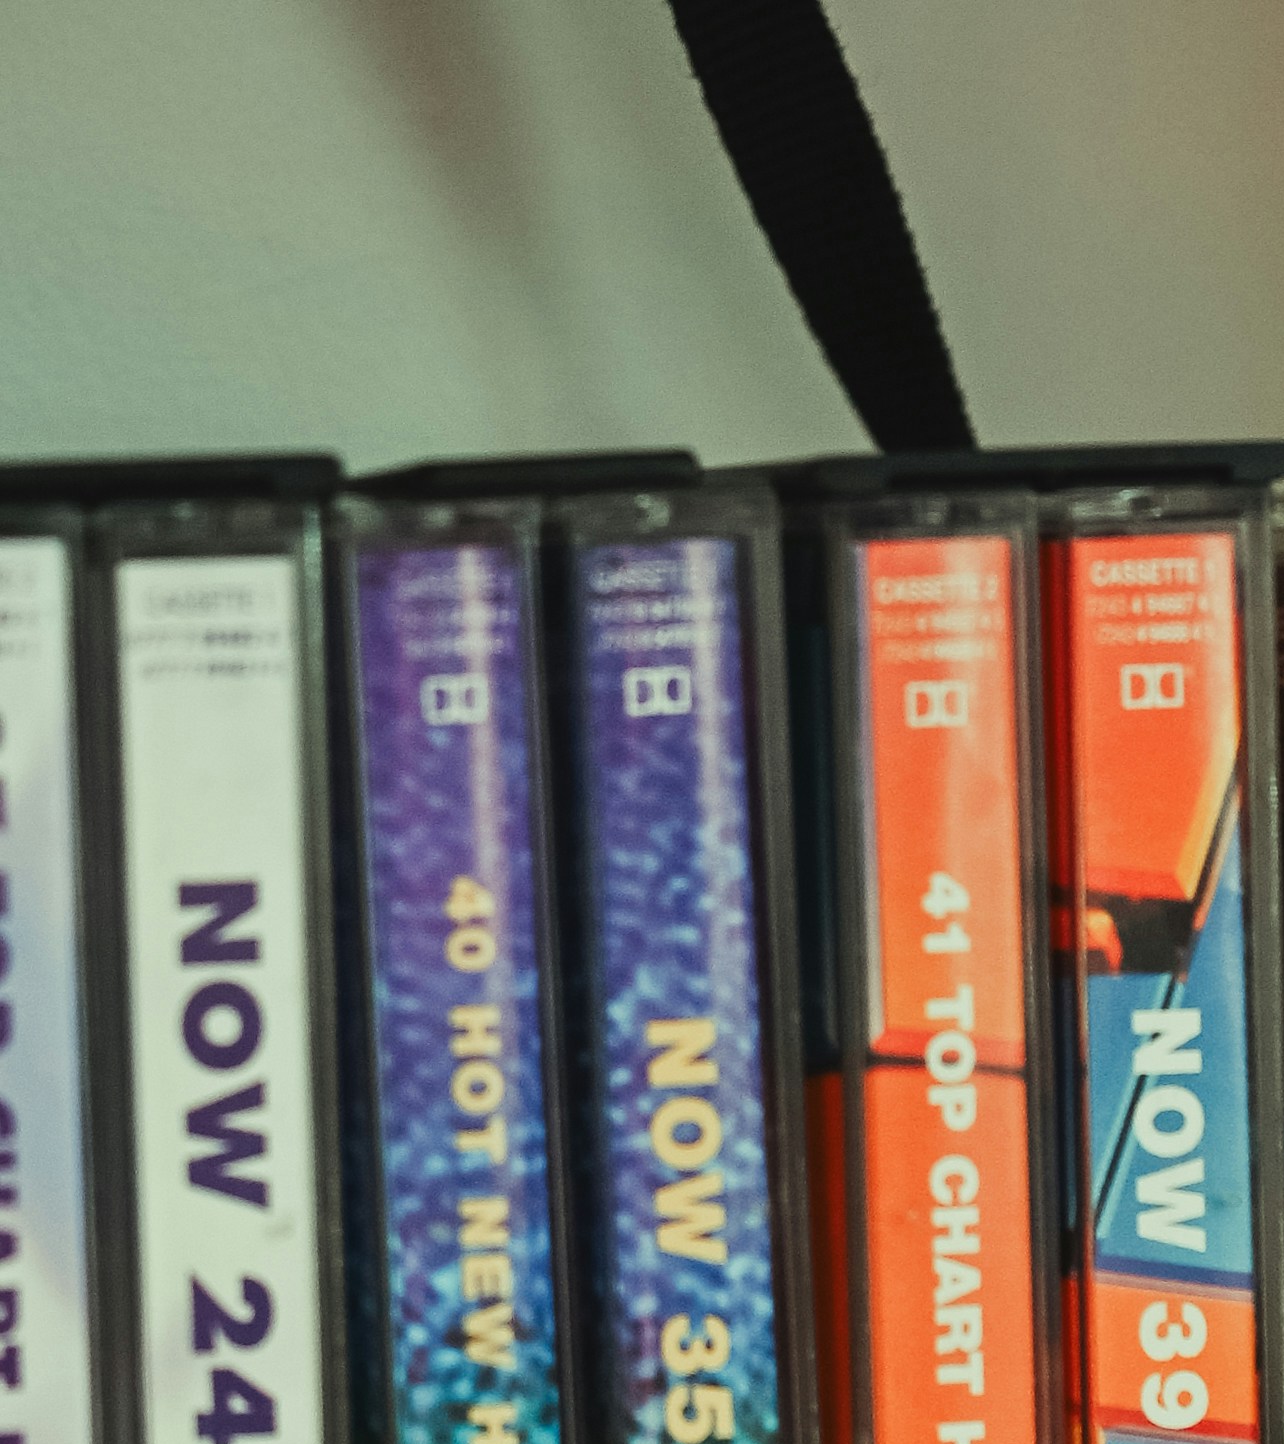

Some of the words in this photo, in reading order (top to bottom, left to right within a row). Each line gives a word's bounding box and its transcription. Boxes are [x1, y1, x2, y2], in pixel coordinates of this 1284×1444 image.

[443, 874, 498, 972] 40
[920, 869, 972, 954] 41
[178, 879, 271, 1211] NOW
[449, 1003, 508, 1166] HOT
[924, 982, 978, 1133] TOP
[645, 1017, 729, 1267] NOW
[1131, 1007, 1207, 1254] NOW
[457, 1196, 517, 1371] NEW
[928, 1153, 984, 1397] CHART
[1139, 1300, 1209, 1430] 39
